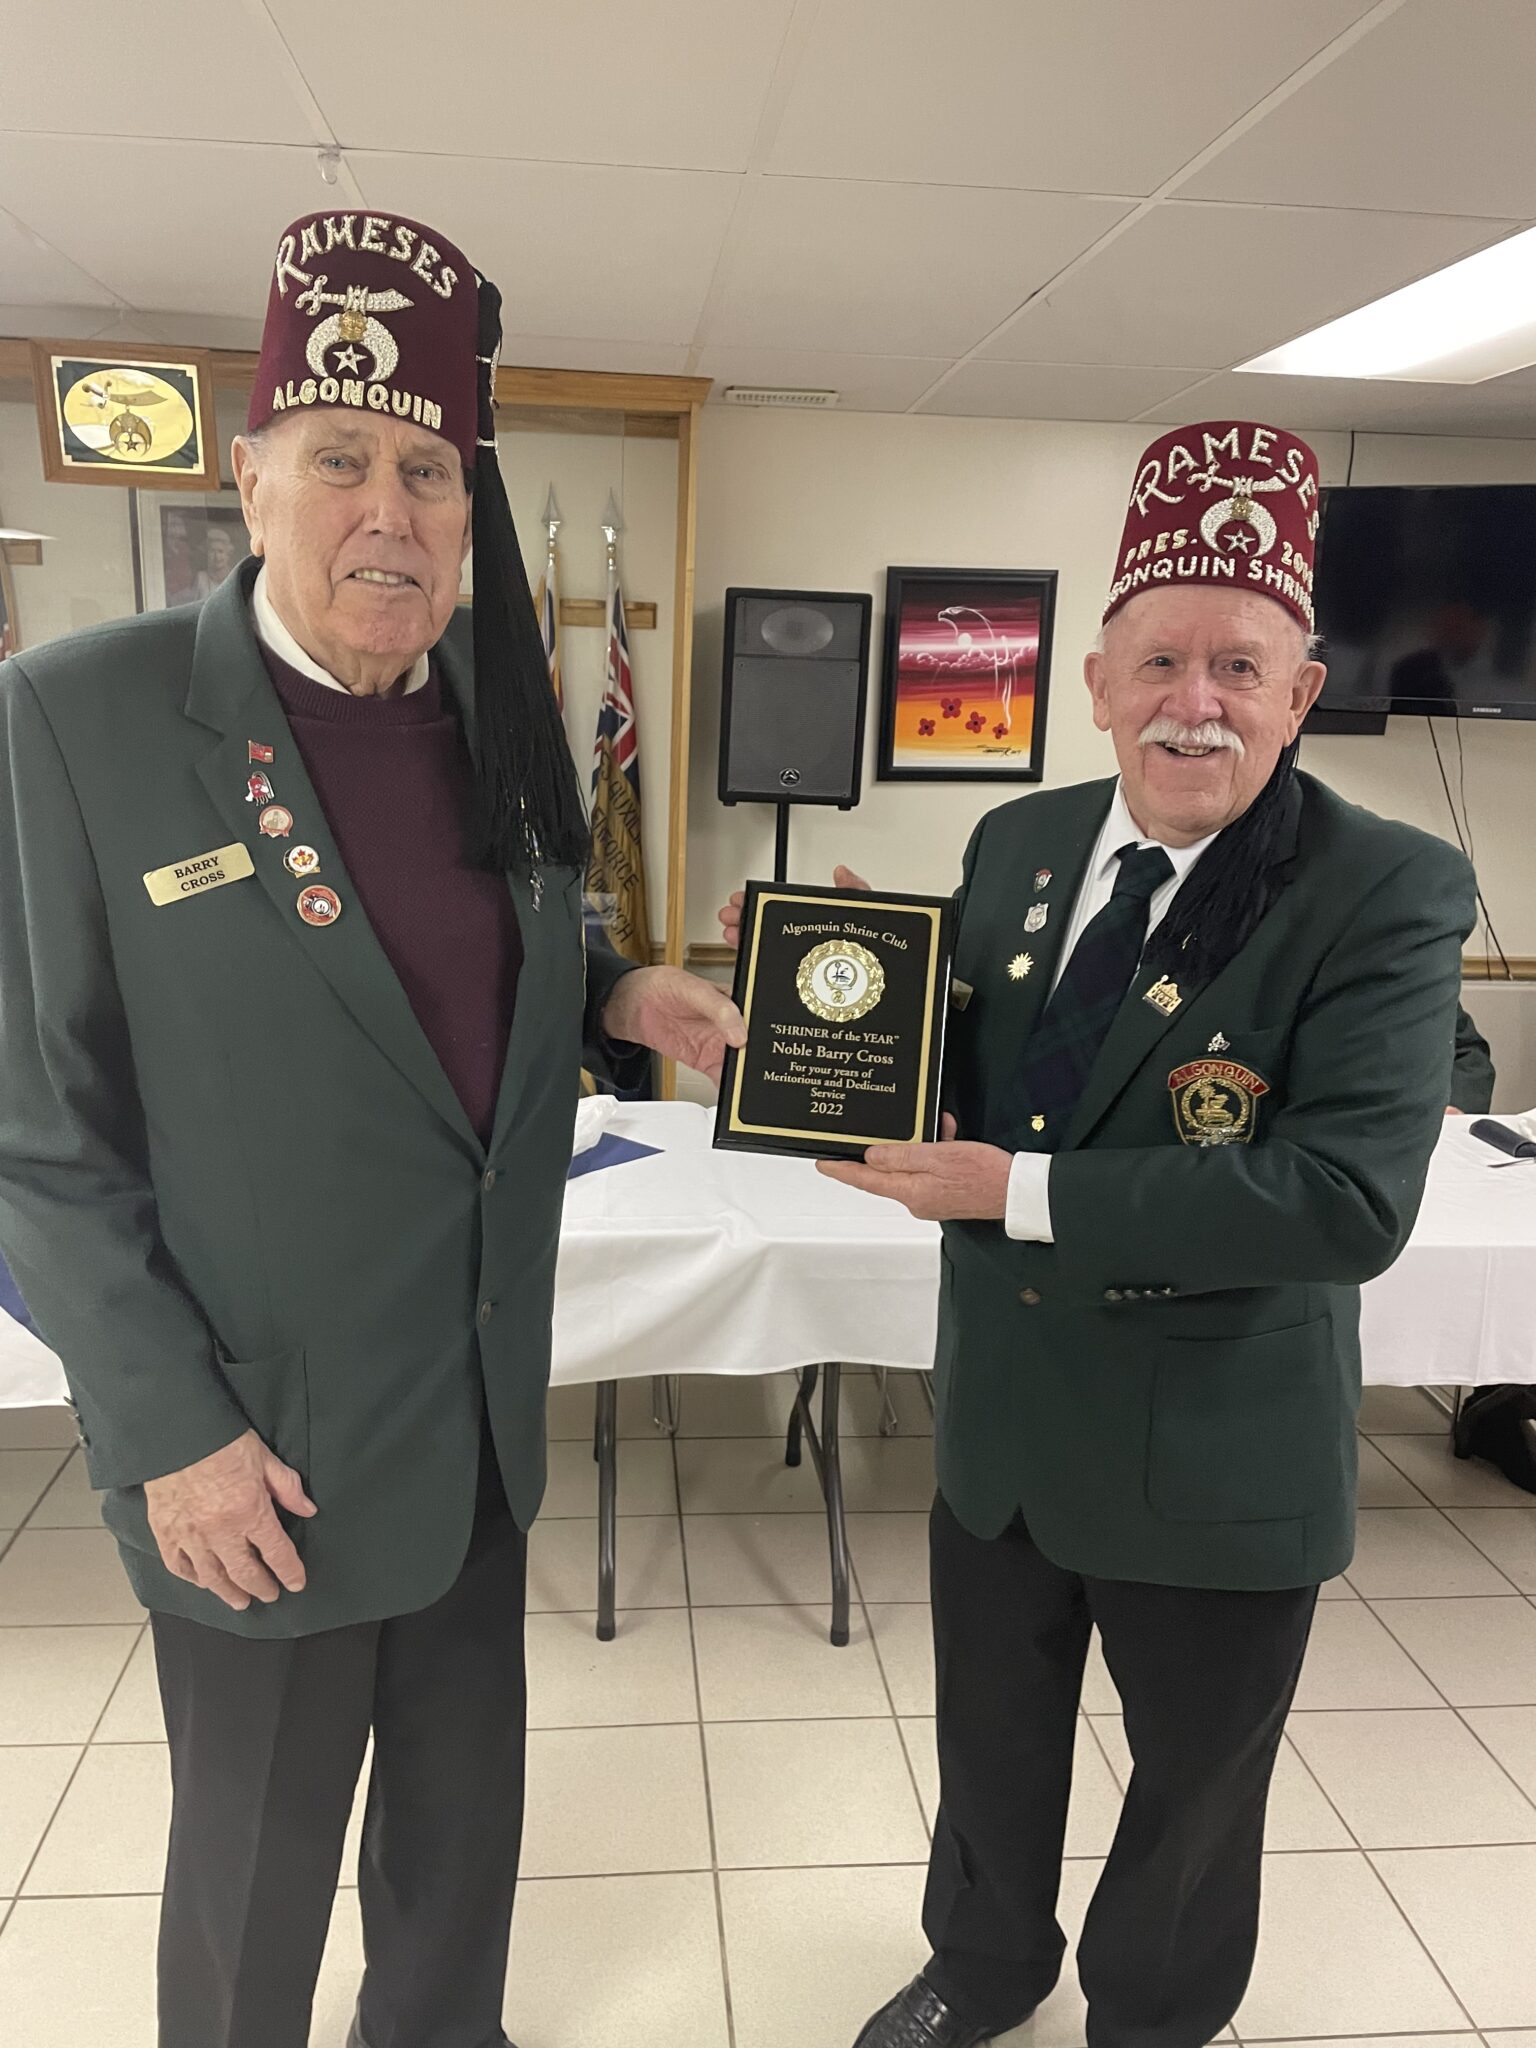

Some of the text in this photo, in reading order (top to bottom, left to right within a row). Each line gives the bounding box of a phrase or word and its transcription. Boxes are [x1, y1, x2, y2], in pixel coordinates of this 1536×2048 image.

[275, 213, 459, 300] RAMESES
[272, 376, 442, 430] ALGONQUIN
[1128, 426, 1320, 541] RAMESES
[173, 856, 220, 879] BARRY
[180, 870, 226, 892] CROSS
[782, 921, 908, 950] Algonquin Shrine Club
[831, 1030, 845, 1040] of
[845, 1031, 861, 1042] the
[772, 1041, 894, 1065] Noble Barry Cross
[763, 1070, 897, 1093] Meritorious and Dedicated
[790, 1061, 874, 1079] For your years of
[1171, 1063, 1260, 1090] ALGONQUIN
[810, 1087, 846, 1100] Service
[810, 1101, 844, 1116] 2022
